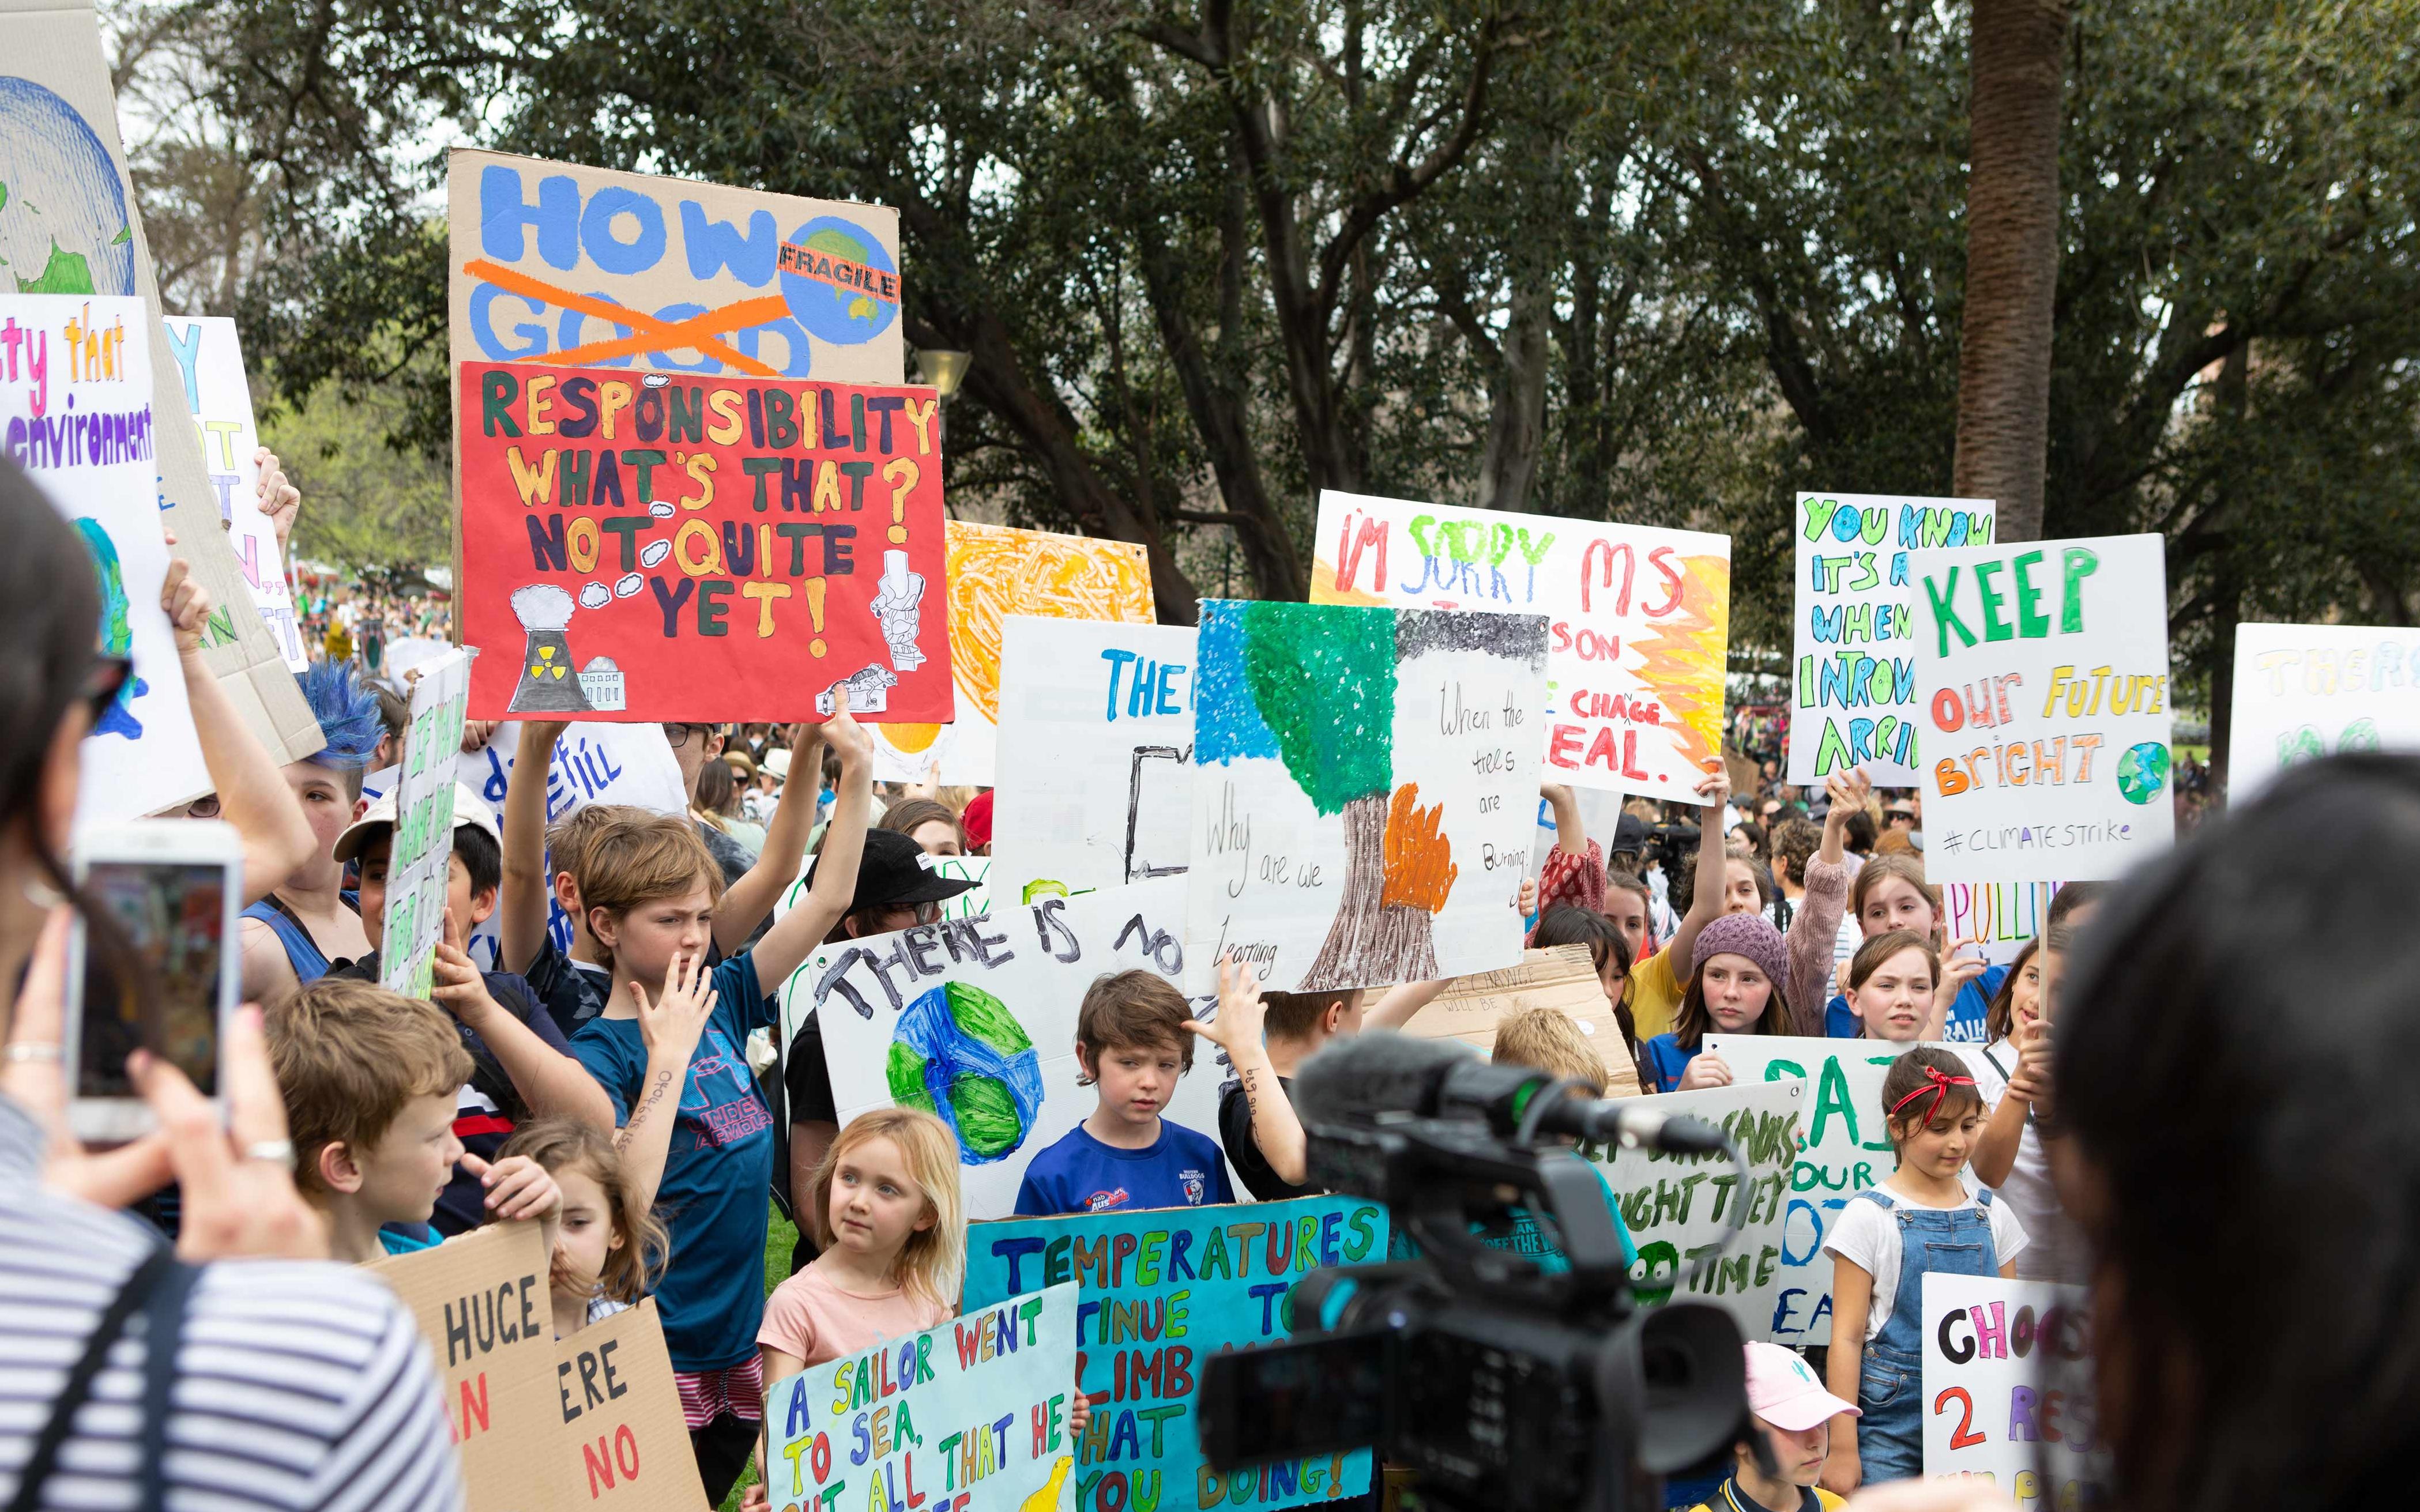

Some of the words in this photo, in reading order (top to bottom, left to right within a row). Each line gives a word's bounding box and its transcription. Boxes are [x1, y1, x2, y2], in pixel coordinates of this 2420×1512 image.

[481, 165, 778, 288] HOW
[778, 240, 898, 299] FRAGILE
[0, 316, 47, 419] ty
[64, 301, 124, 383] that
[5, 393, 153, 472] environment
[482, 370, 936, 456] RESPONSIBILITY
[506, 445, 719, 511] WHAT'S
[742, 457, 921, 545] THAT?
[1802, 497, 1888, 546] YOU
[1898, 503, 1993, 550] KNOW
[526, 513, 654, 574] NOT
[674, 518, 857, 578] QUITE
[1401, 514, 1556, 604] SORRY
[1580, 537, 1685, 617] MS
[1812, 550, 1880, 594] IT'S
[650, 576, 827, 659] YET!
[1811, 603, 1913, 644] WHEN
[1922, 547, 2098, 659] KEEP
[1550, 621, 1620, 662] SON
[1101, 648, 1196, 723] THE
[1441, 679, 1490, 736] When
[1503, 689, 1524, 728] the
[1800, 651, 1917, 710] INTROV
[1472, 748, 1516, 775] trees
[1543, 723, 1669, 783] EAL.
[1479, 794, 1501, 815] are
[1207, 779, 1252, 899] Why
[1259, 854, 1290, 885] are
[1297, 862, 1323, 888] we
[1482, 842, 1530, 908] Burning!
[815, 912, 1015, 1020] THERE
[1031, 899, 1081, 964] IS
[1113, 913, 1183, 976] NO
[1212, 914, 1278, 981] Learning
[1442, 998, 1473, 1013] WILL
[1480, 997, 1497, 1011] BE
[1093, 1194, 1105, 1202] nab
[1790, 1160, 1876, 1191] OUR
[991, 1206, 1380, 1296] TEMPERATURES
[1684, 1243, 1779, 1296] TIME
[444, 1273, 541, 1368] HUGE
[1075, 1289, 1191, 1347] TINUE
[557, 1338, 628, 1425] ERE
[785, 1376, 811, 1439] A
[831, 1333, 935, 1416] SAILOR
[954, 1296, 1043, 1372] WENT
[1075, 1345, 1195, 1407] LIMB
[782, 1431, 831, 1497] TO
[849, 1399, 923, 1466] SEA,
[1074, 1404, 1186, 1466] HAT
[1934, 1386, 1987, 1451] 2
[582, 1423, 640, 1500] NO
[868, 1451, 926, 1512] ALL
[938, 1412, 1014, 1492] THAT
[1031, 1393, 1065, 1460] HE
[1074, 1468, 1162, 1512] YOU
